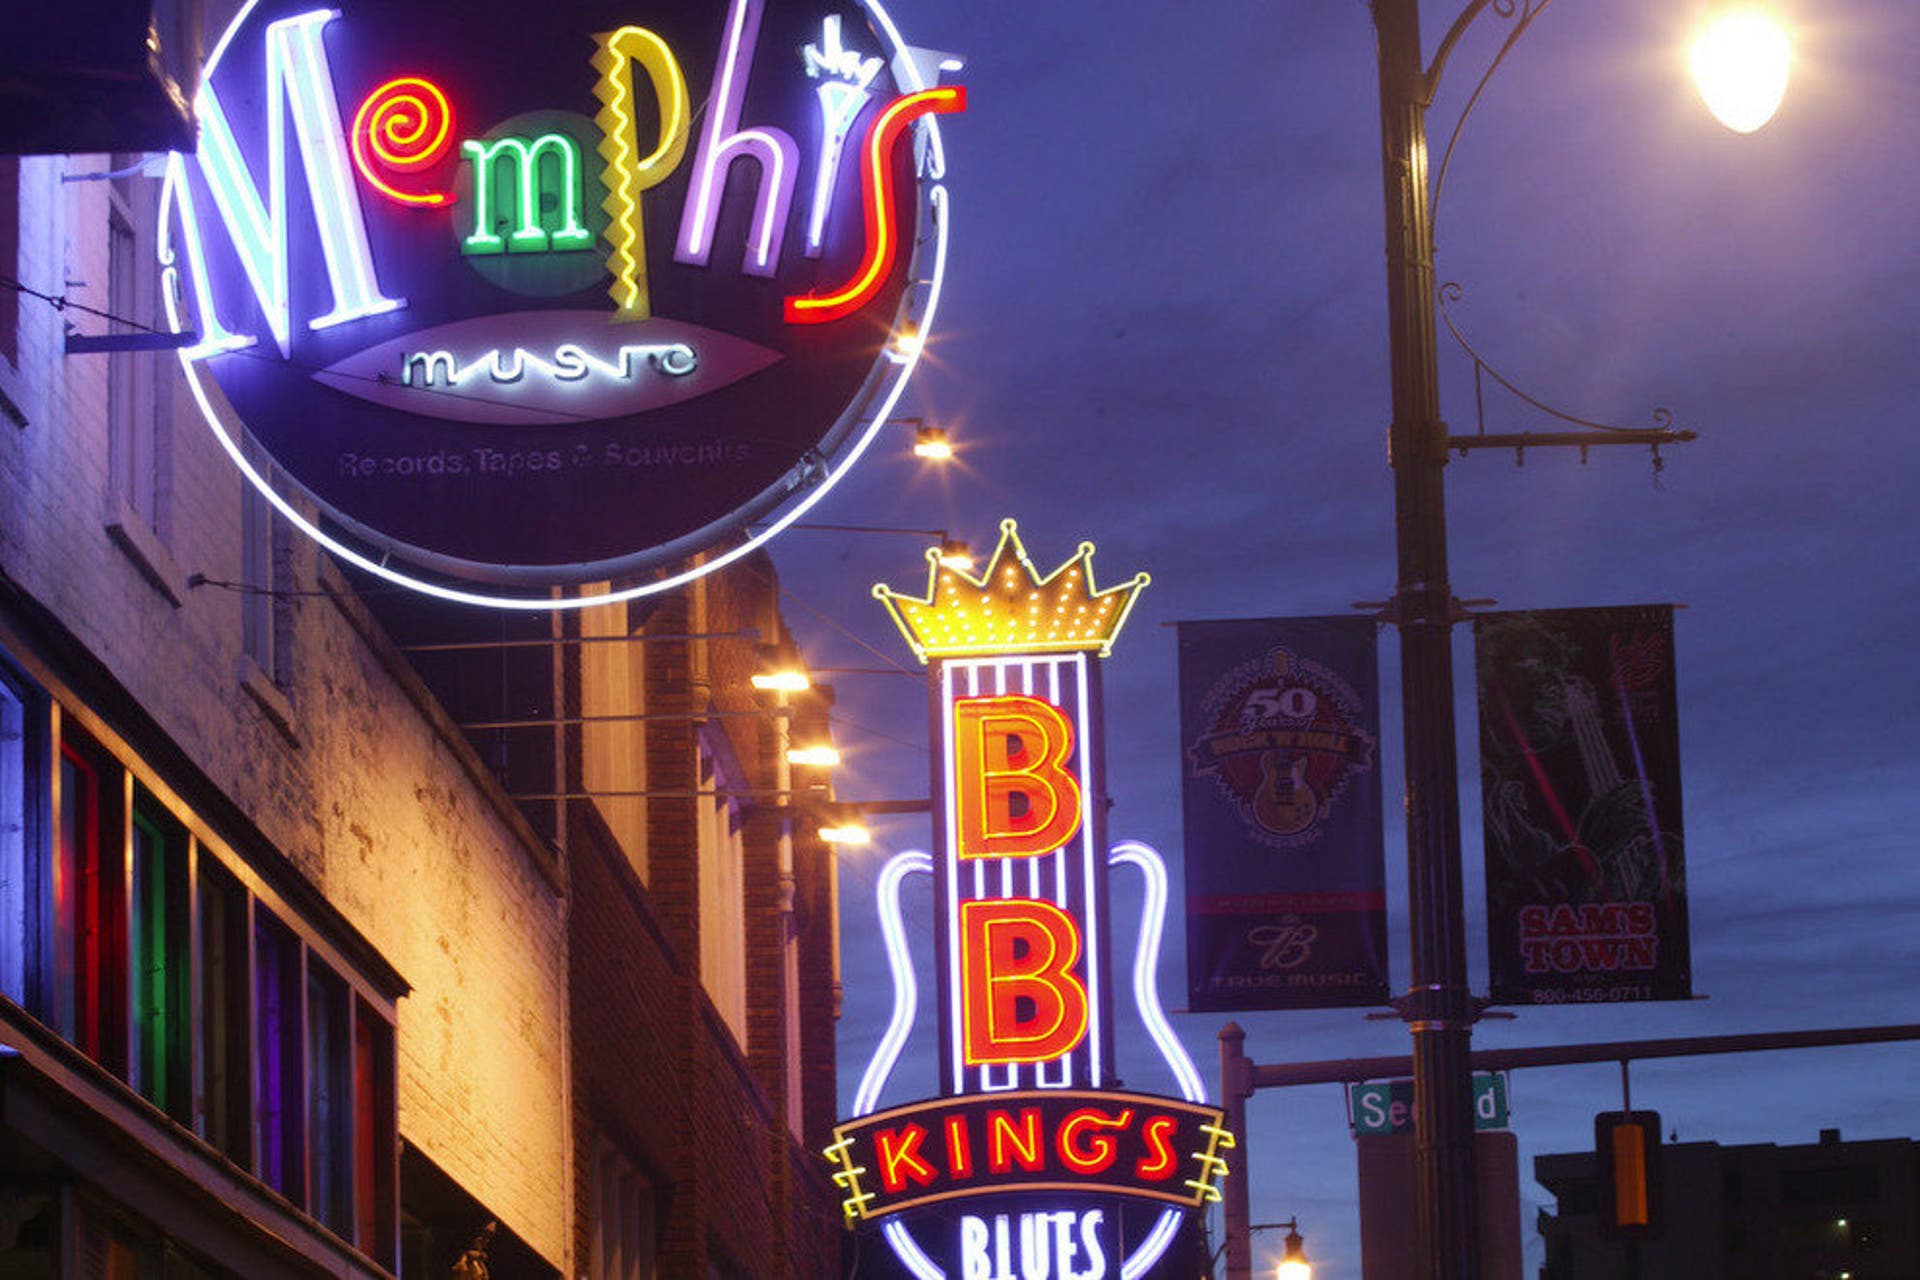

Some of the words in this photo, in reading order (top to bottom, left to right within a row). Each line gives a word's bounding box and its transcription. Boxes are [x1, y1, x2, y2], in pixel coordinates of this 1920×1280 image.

[1241, 687, 1317, 717] 50
[1521, 936, 1658, 972] TOWN
[961, 1209, 1107, 1280] BLUES
